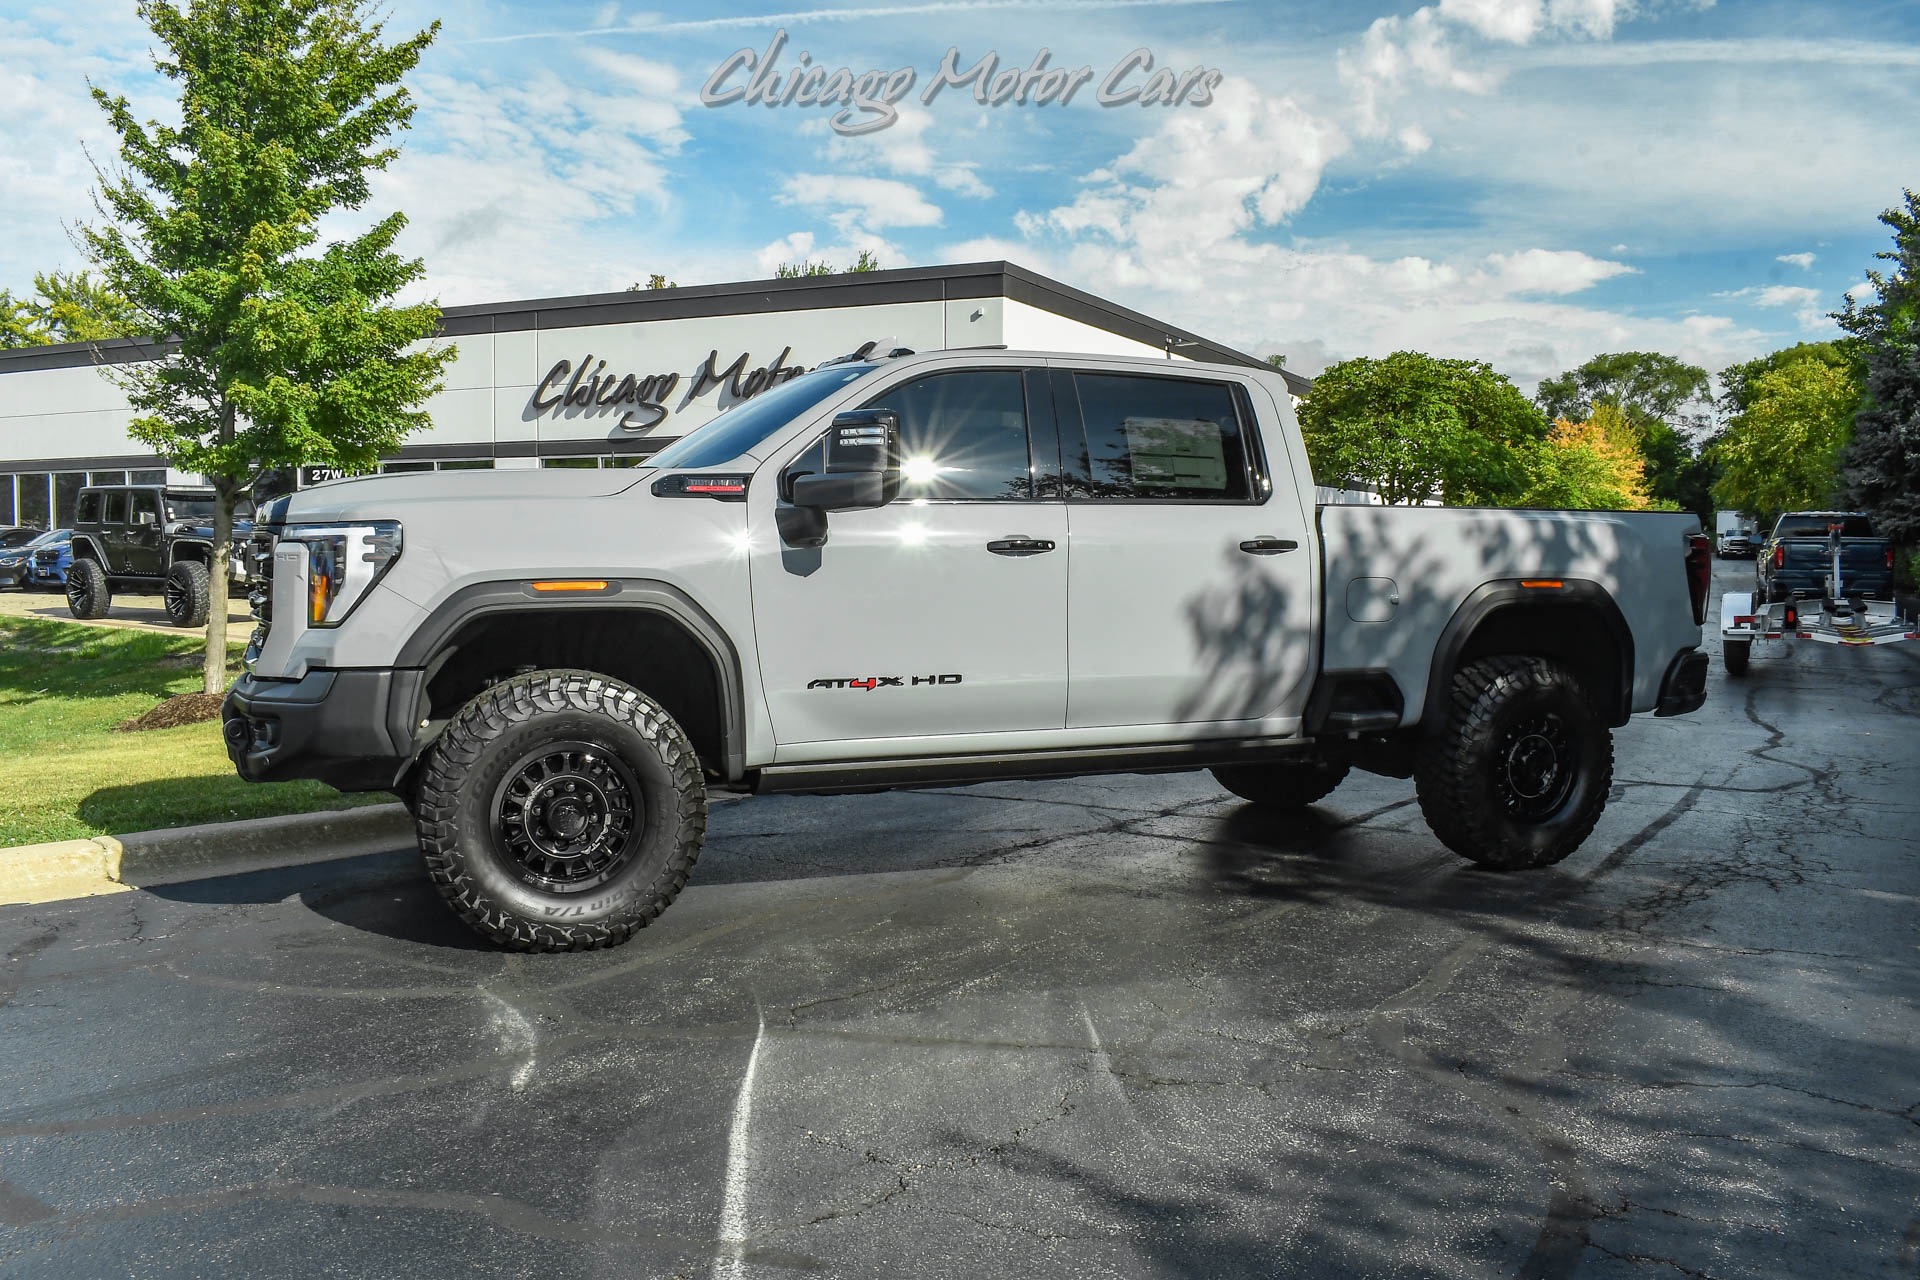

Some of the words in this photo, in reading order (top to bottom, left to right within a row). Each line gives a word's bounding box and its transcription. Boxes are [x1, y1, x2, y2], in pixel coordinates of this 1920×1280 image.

[533, 354, 679, 432] Chicago
[689, 346, 815, 398] Moto
[807, 677, 904, 691] AT4X
[912, 674, 962, 686] HD
